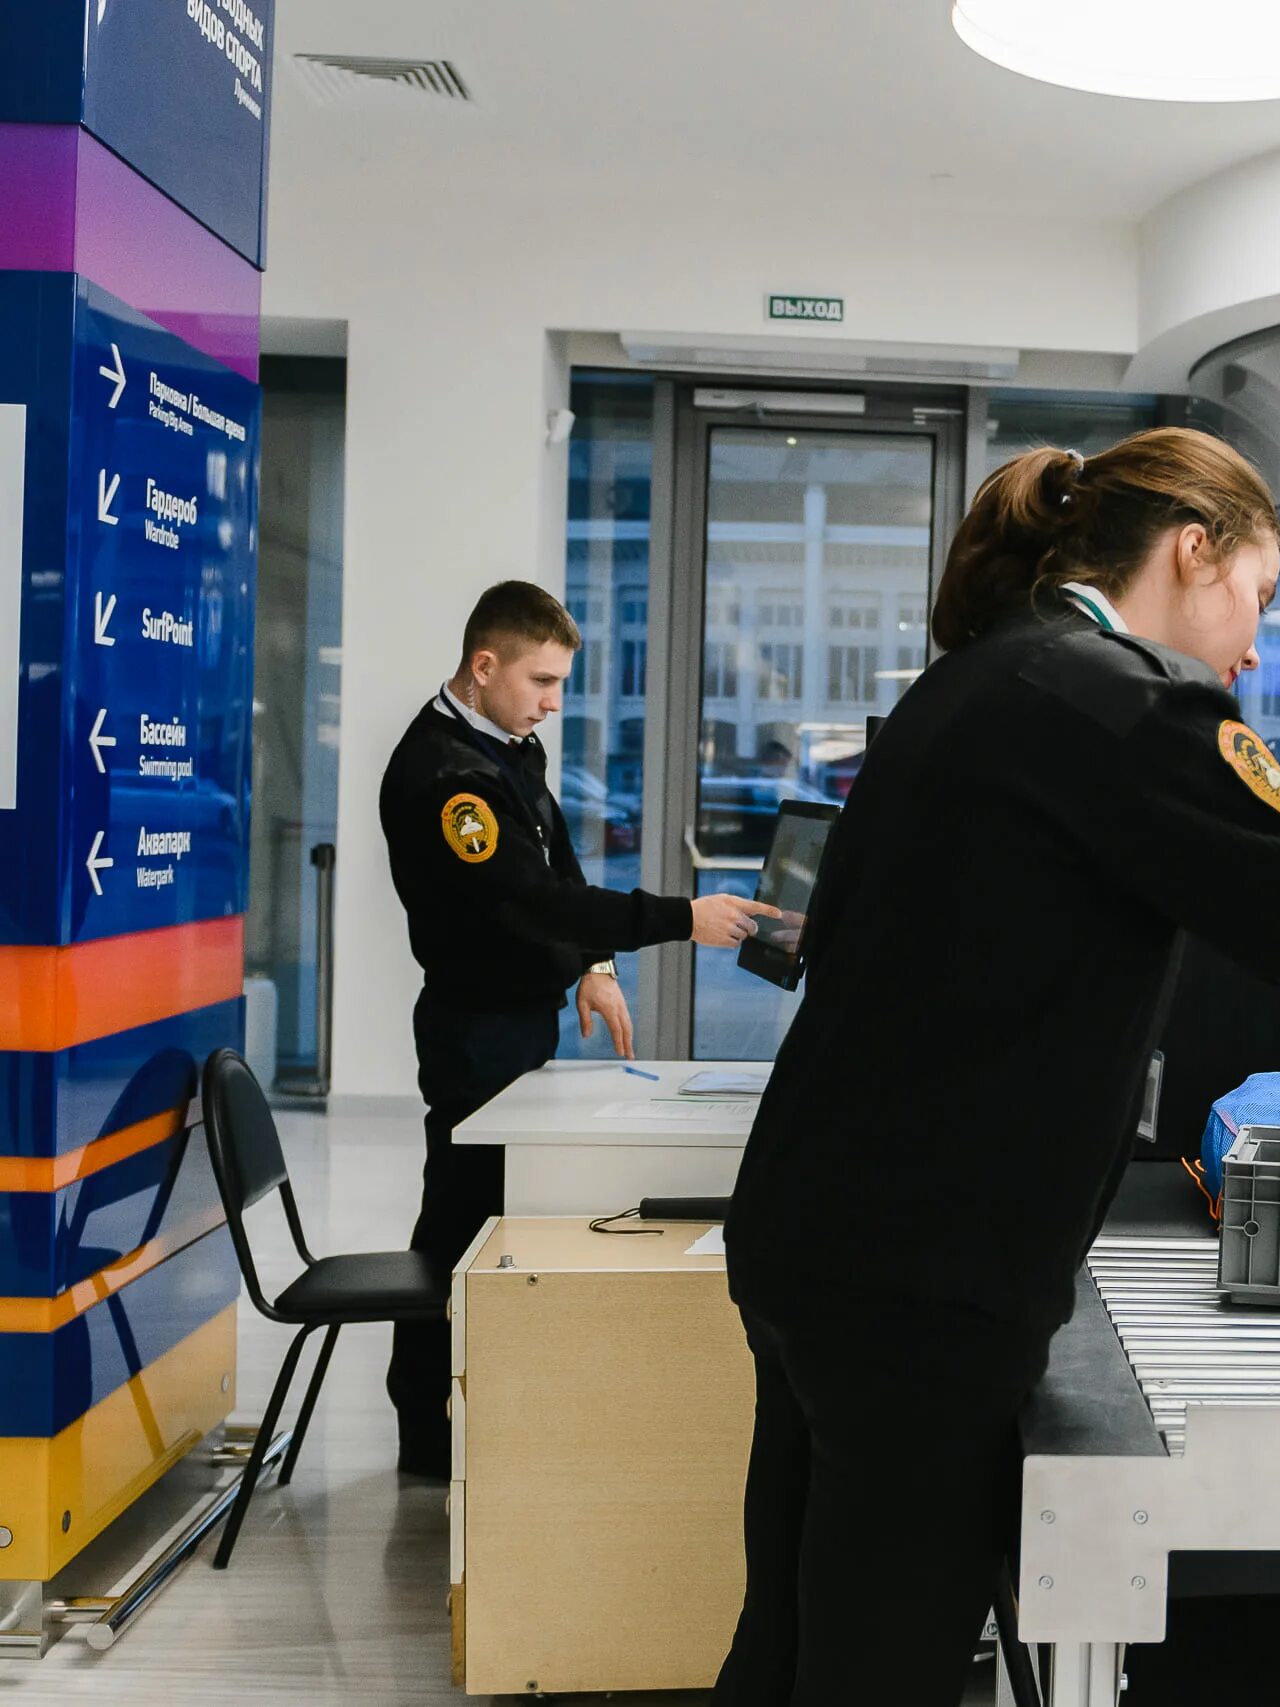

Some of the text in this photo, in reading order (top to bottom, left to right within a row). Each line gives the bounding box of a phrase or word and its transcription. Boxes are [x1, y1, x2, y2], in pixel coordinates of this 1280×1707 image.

[187, 0, 262, 93] ВИДОВ СПОРТА
[772, 299, 842, 320] ВЫХОД
[146, 478, 198, 527] Гардероб
[144, 519, 180, 550] Wardrobe
[141, 607, 193, 647] SurfPoint
[140, 713, 187, 747] Бассейн
[139, 754, 177, 781] Swimming
[137, 826, 191, 861] Аквапарк
[136, 864, 174, 890] Waterpark
